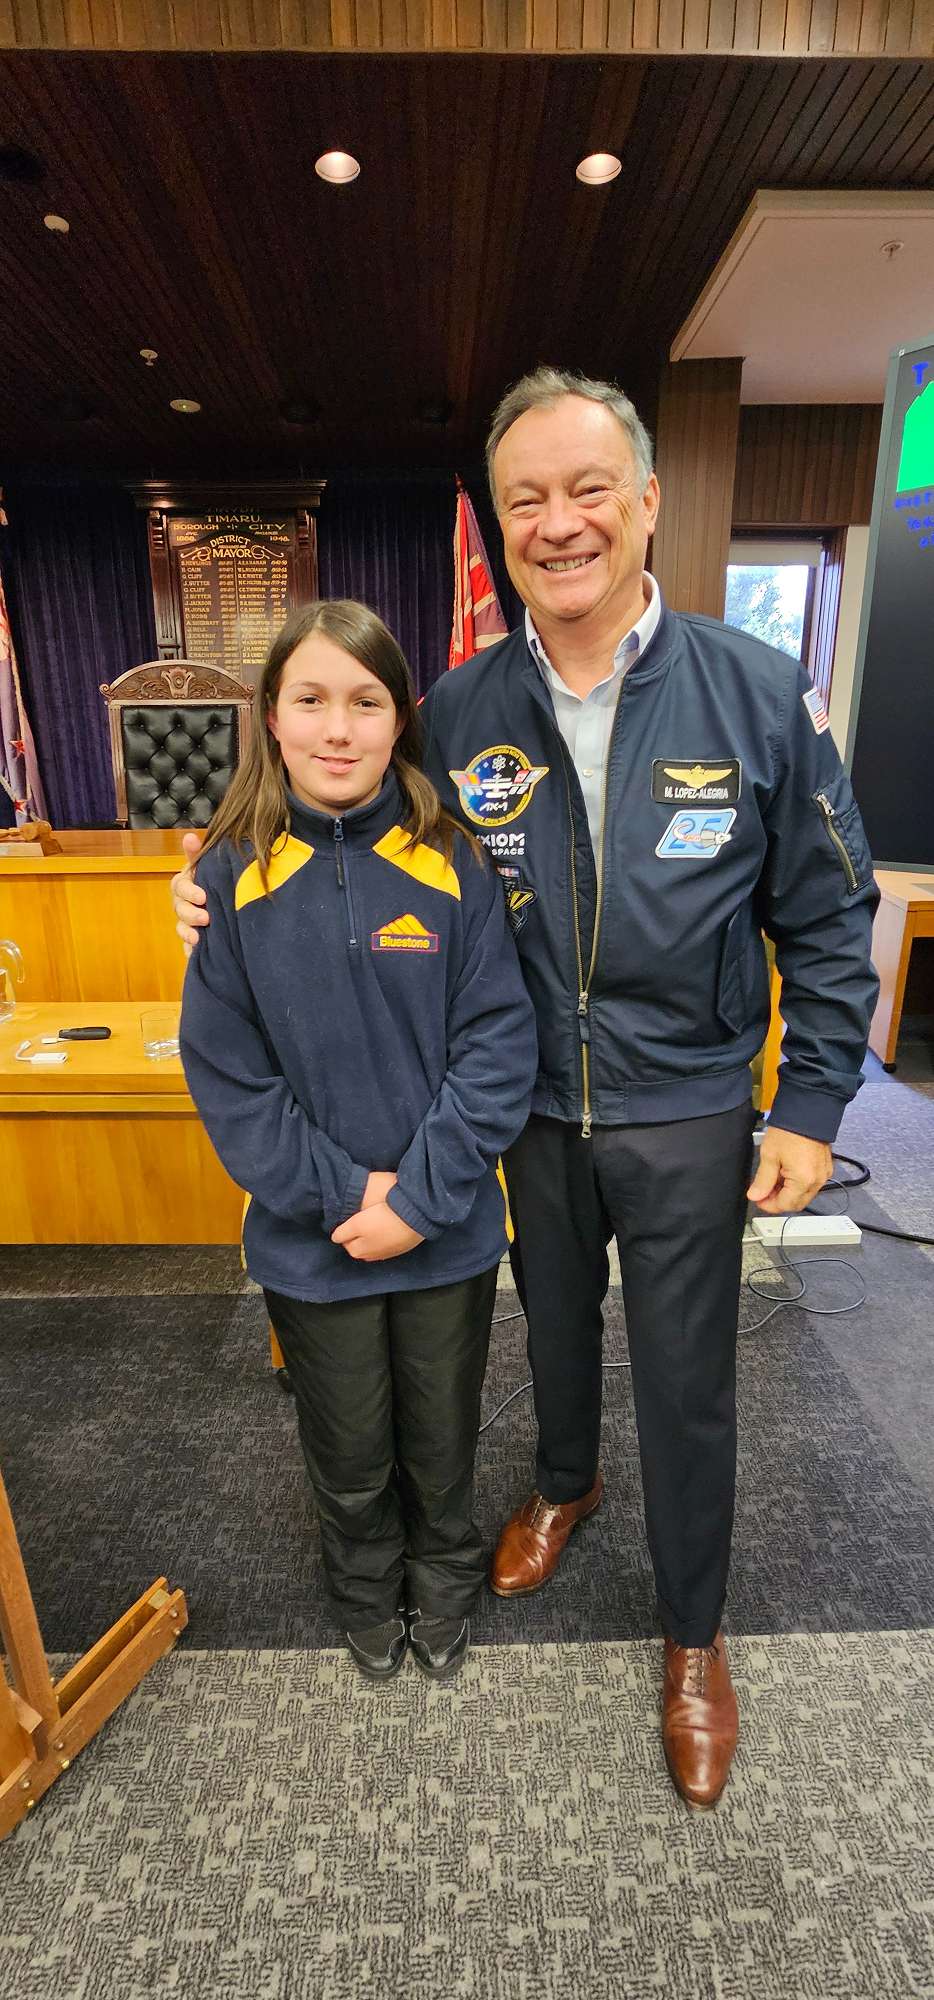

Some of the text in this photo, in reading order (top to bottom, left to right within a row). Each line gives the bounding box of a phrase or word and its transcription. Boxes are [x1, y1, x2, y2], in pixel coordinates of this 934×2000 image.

[173, 523, 286, 531] BOROUGH CITY
[210, 534, 251, 548] DISTRICT
[212, 548, 252, 558] MAYOR
[674, 787, 729, 800] LOPEZ-ALEGRIA
[476, 833, 526, 848] XIOM
[491, 847, 525, 856] SPACE
[379, 936, 431, 949] Bluestone
